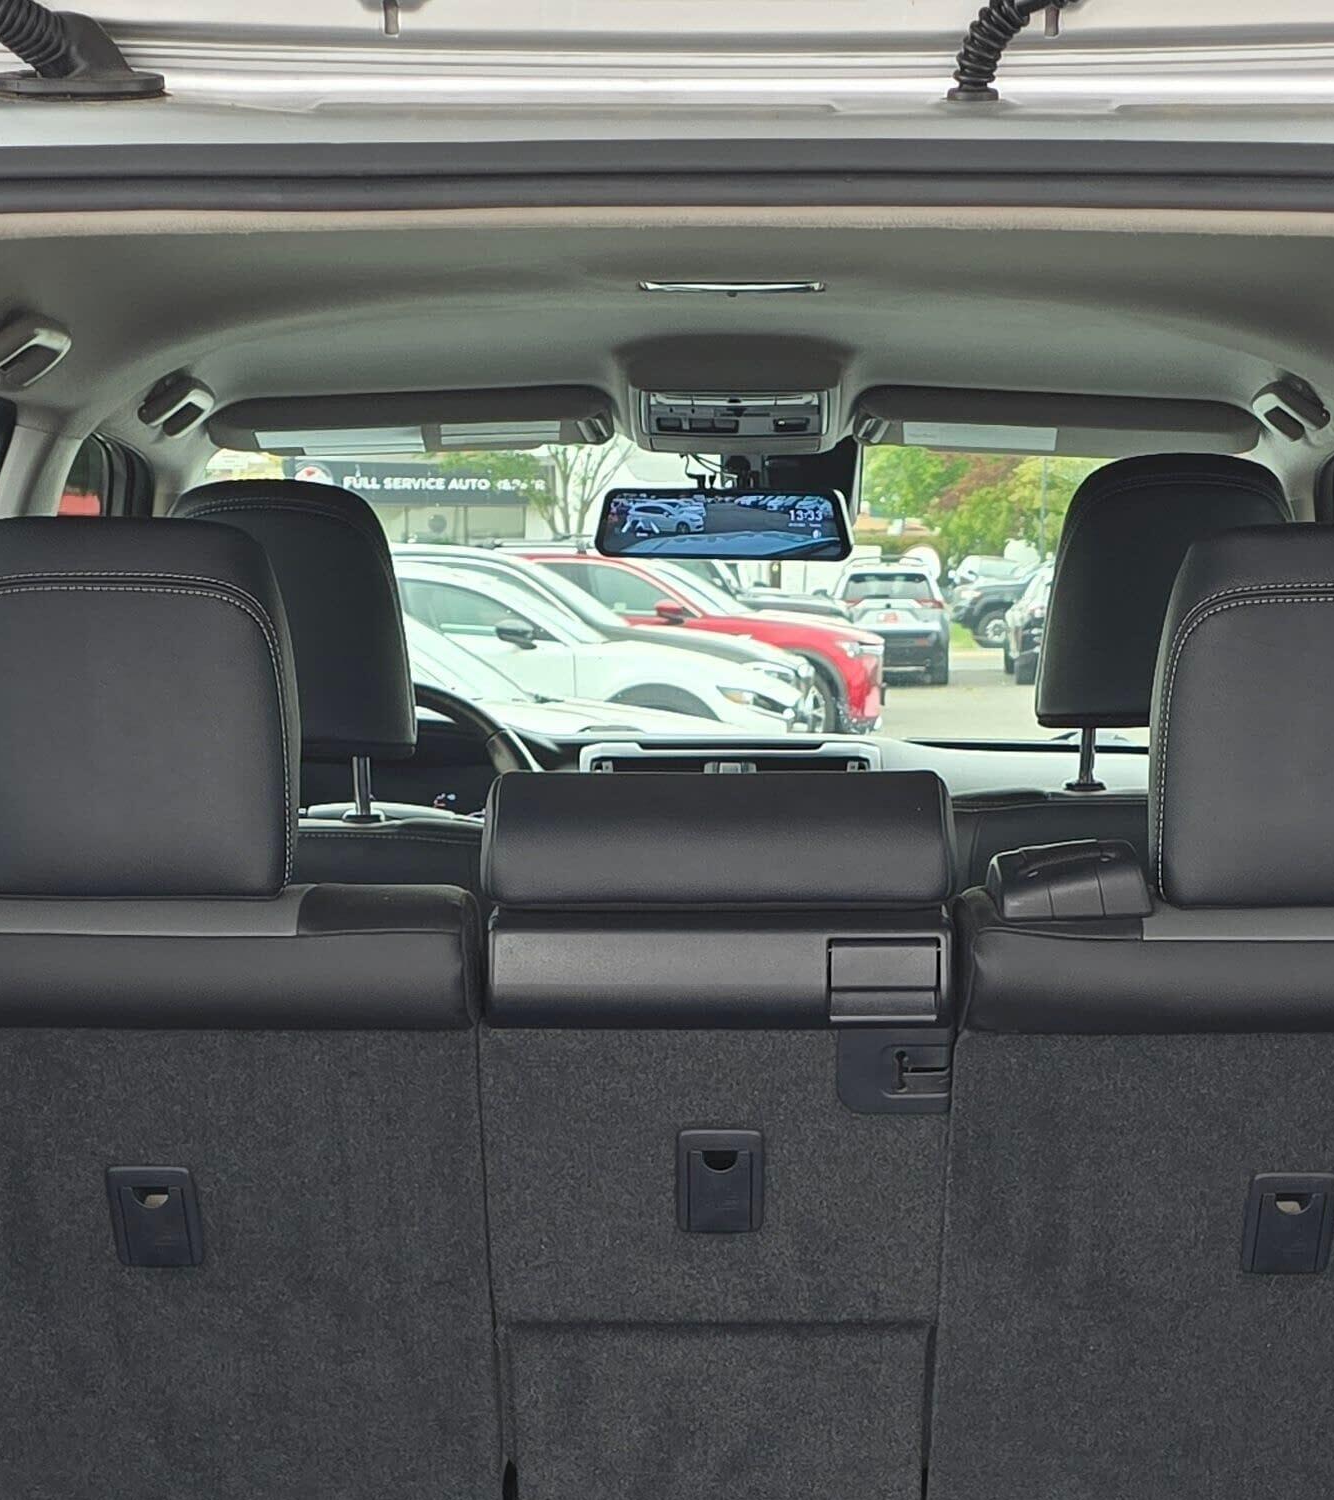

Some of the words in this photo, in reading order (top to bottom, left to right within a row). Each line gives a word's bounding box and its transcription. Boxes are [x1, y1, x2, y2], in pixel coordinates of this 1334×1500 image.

[343, 476, 381, 490] FULL
[383, 477, 445, 490] SERVICE
[447, 478, 491, 491] AUTO
[788, 509, 823, 522] 13:33
